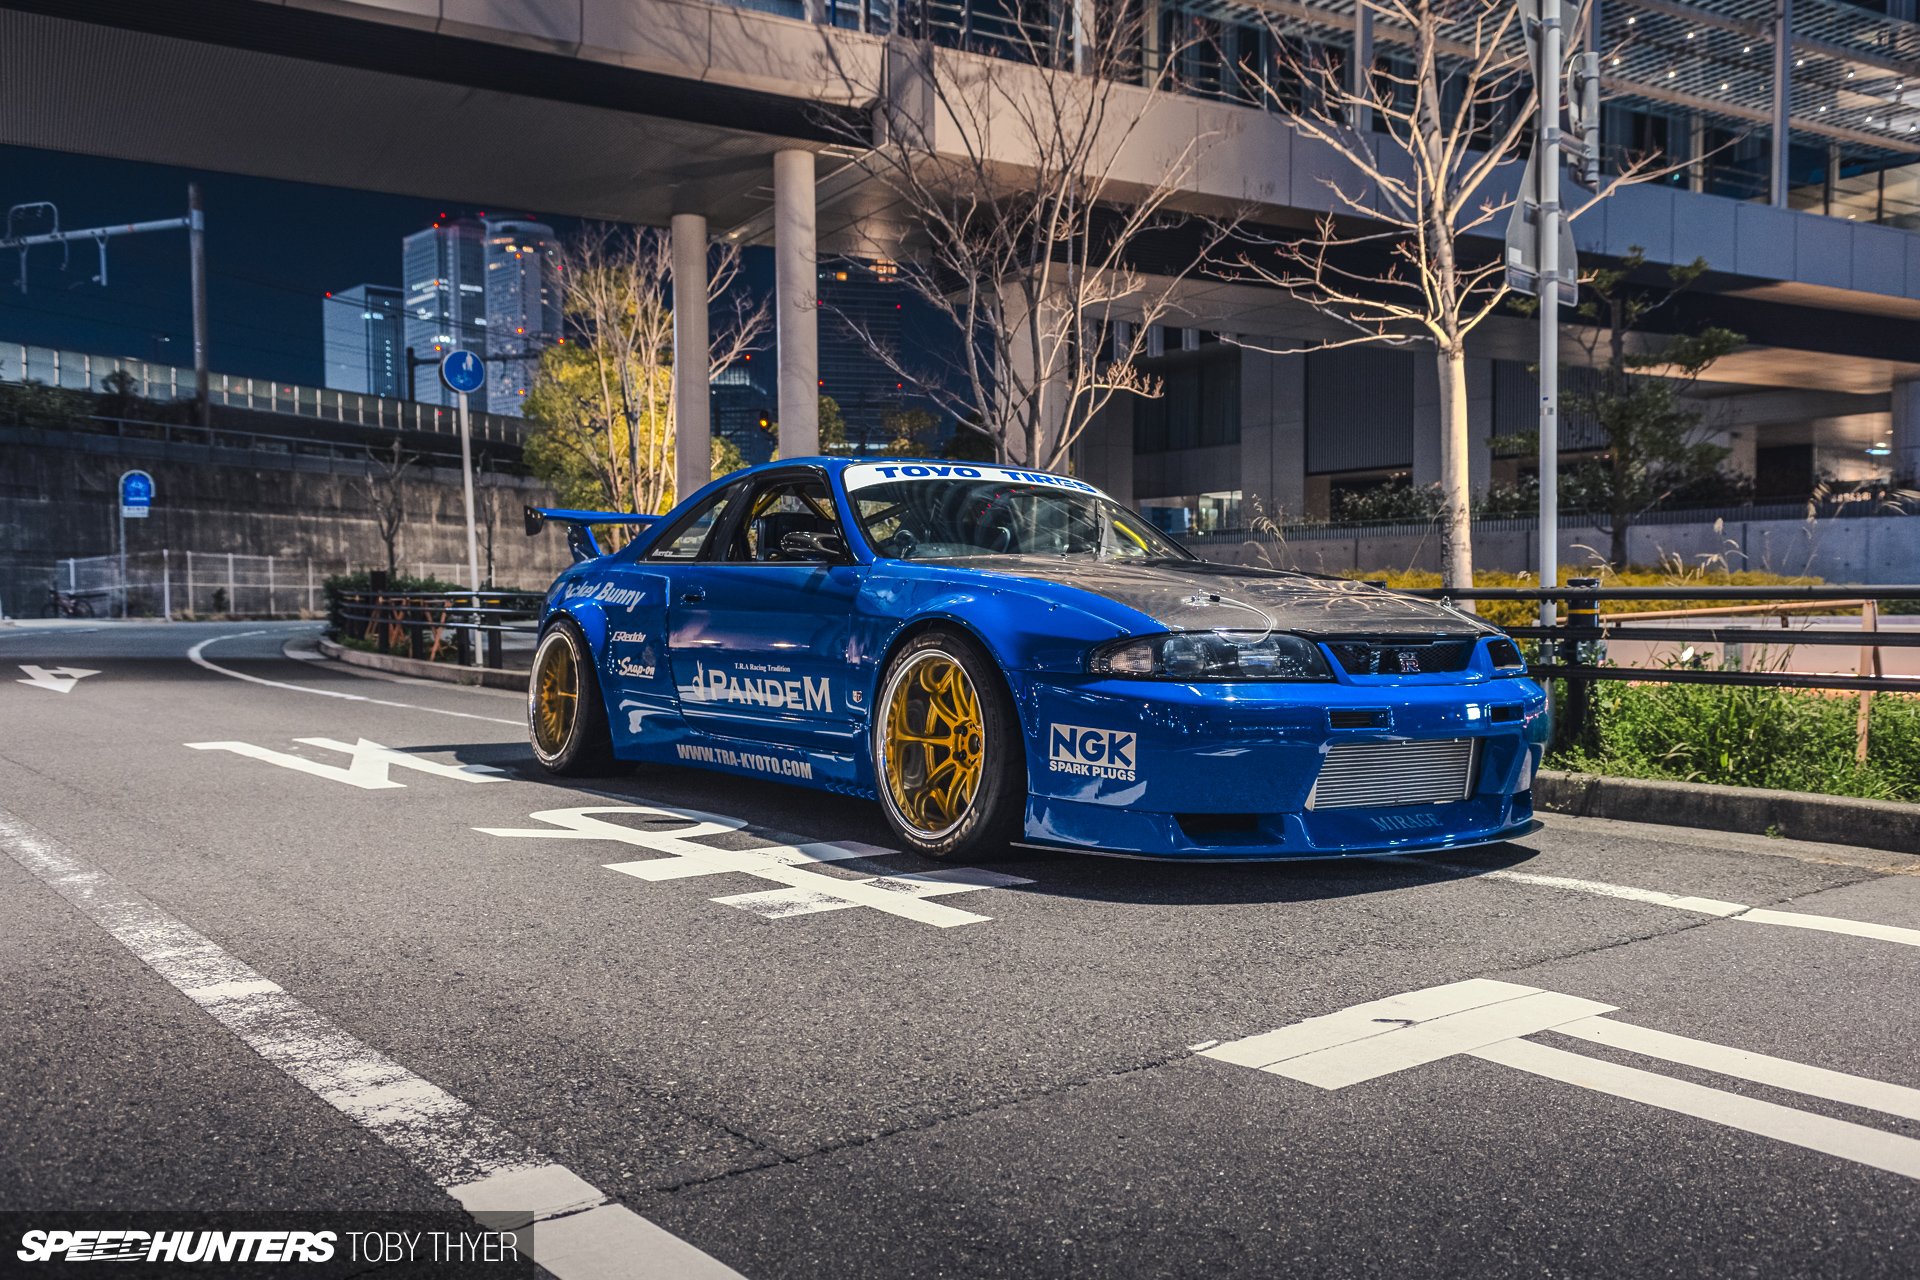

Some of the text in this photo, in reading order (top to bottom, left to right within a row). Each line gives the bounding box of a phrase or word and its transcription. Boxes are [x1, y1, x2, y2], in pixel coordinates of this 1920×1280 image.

[875, 465, 1097, 494] TOYO TIRES
[594, 582, 646, 613] Bunny
[619, 657, 655, 677] Snap-on
[750, 663, 767, 673] Racing
[767, 664, 791, 673] Tradition
[708, 669, 833, 713] PANDEM
[677, 743, 813, 780] WWW.TRA-KYOTO.COM
[1052, 726, 1134, 768] NGK
[1049, 760, 1136, 782] SPARK PLUGS
[1369, 812, 1444, 832] MIRAGE
